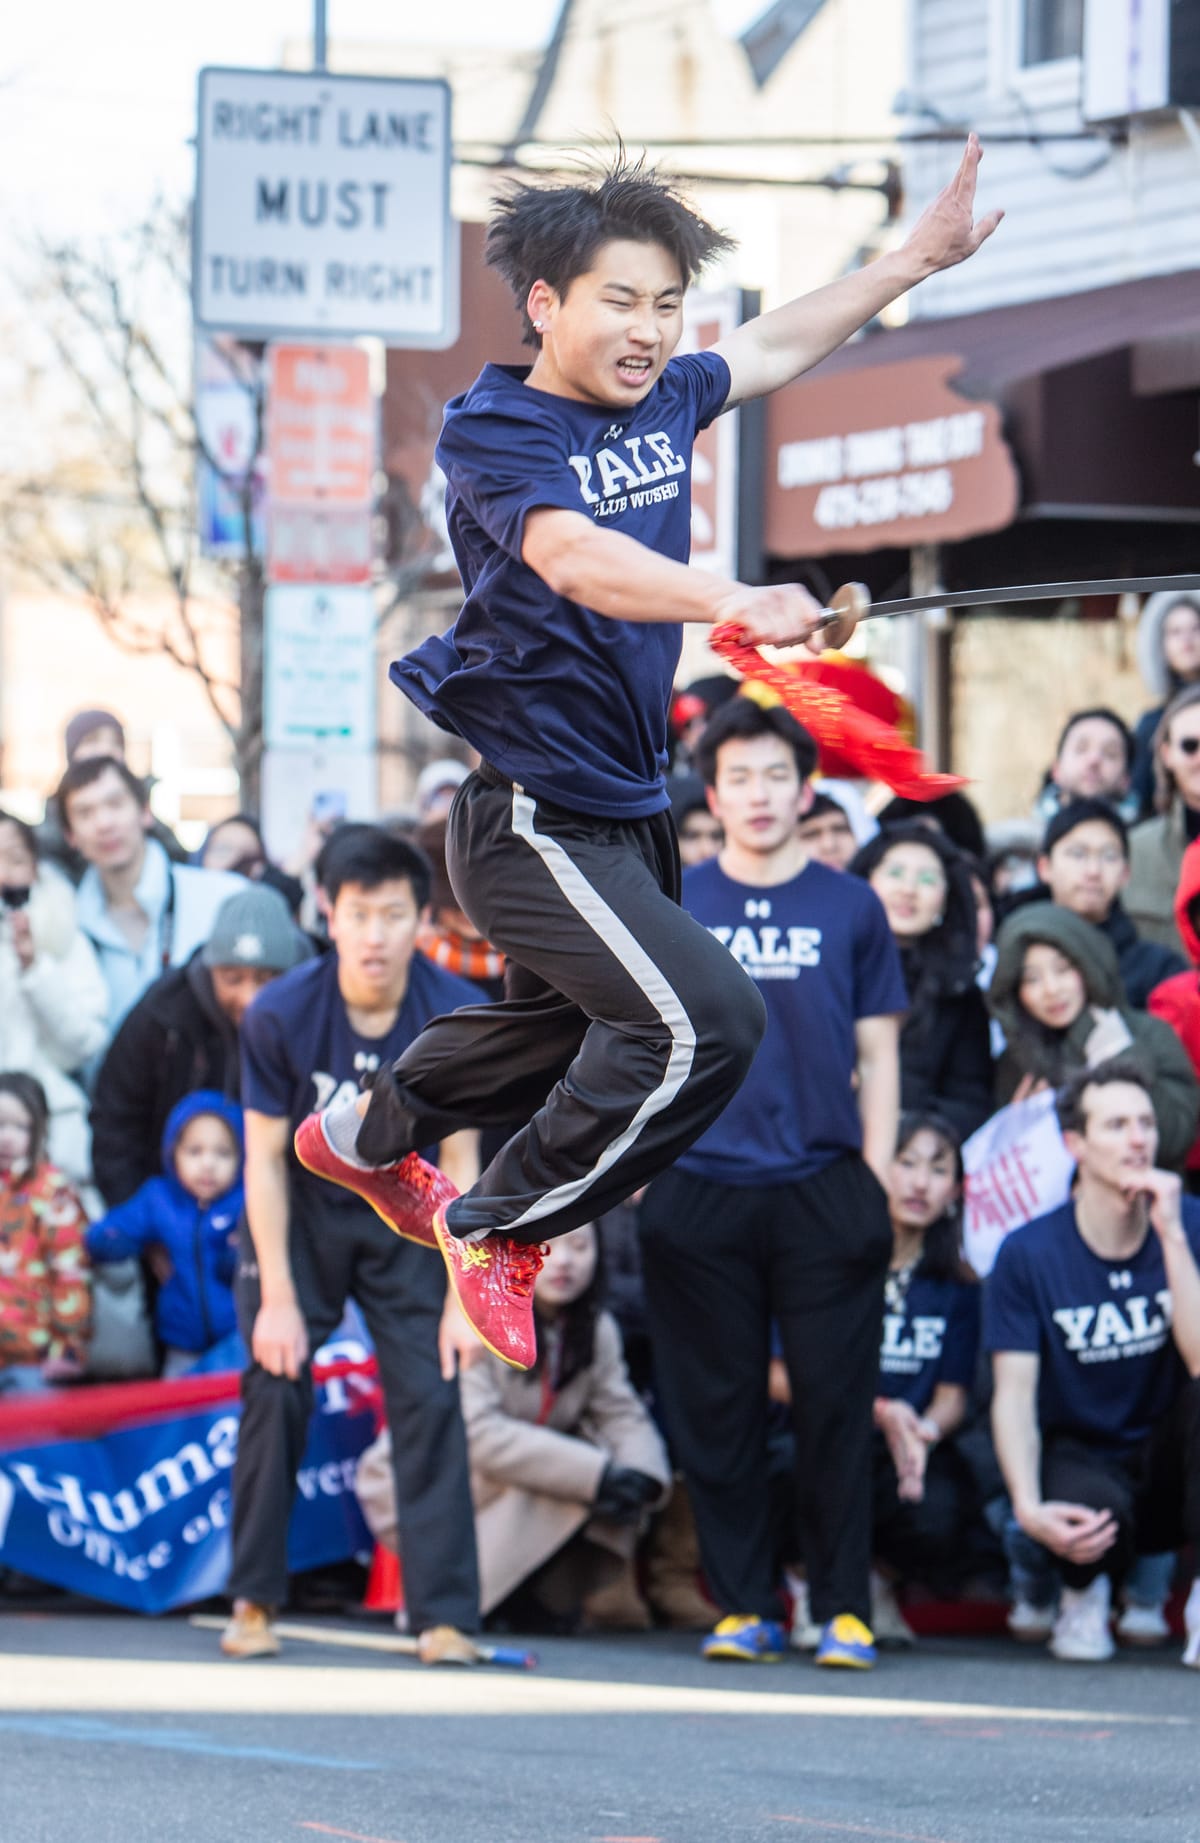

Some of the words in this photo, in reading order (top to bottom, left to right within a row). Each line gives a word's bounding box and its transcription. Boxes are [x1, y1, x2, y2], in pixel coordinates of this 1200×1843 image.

[211, 99, 322, 144] RIGHT
[337, 108, 435, 154] LANE
[255, 177, 391, 231] MUST
[209, 254, 306, 297] TURN
[324, 260, 434, 305] RIGHT
[629, 481, 680, 510] WUSHU
[880, 1314, 947, 1359] LE
[11, 1415, 238, 1534] Huma
